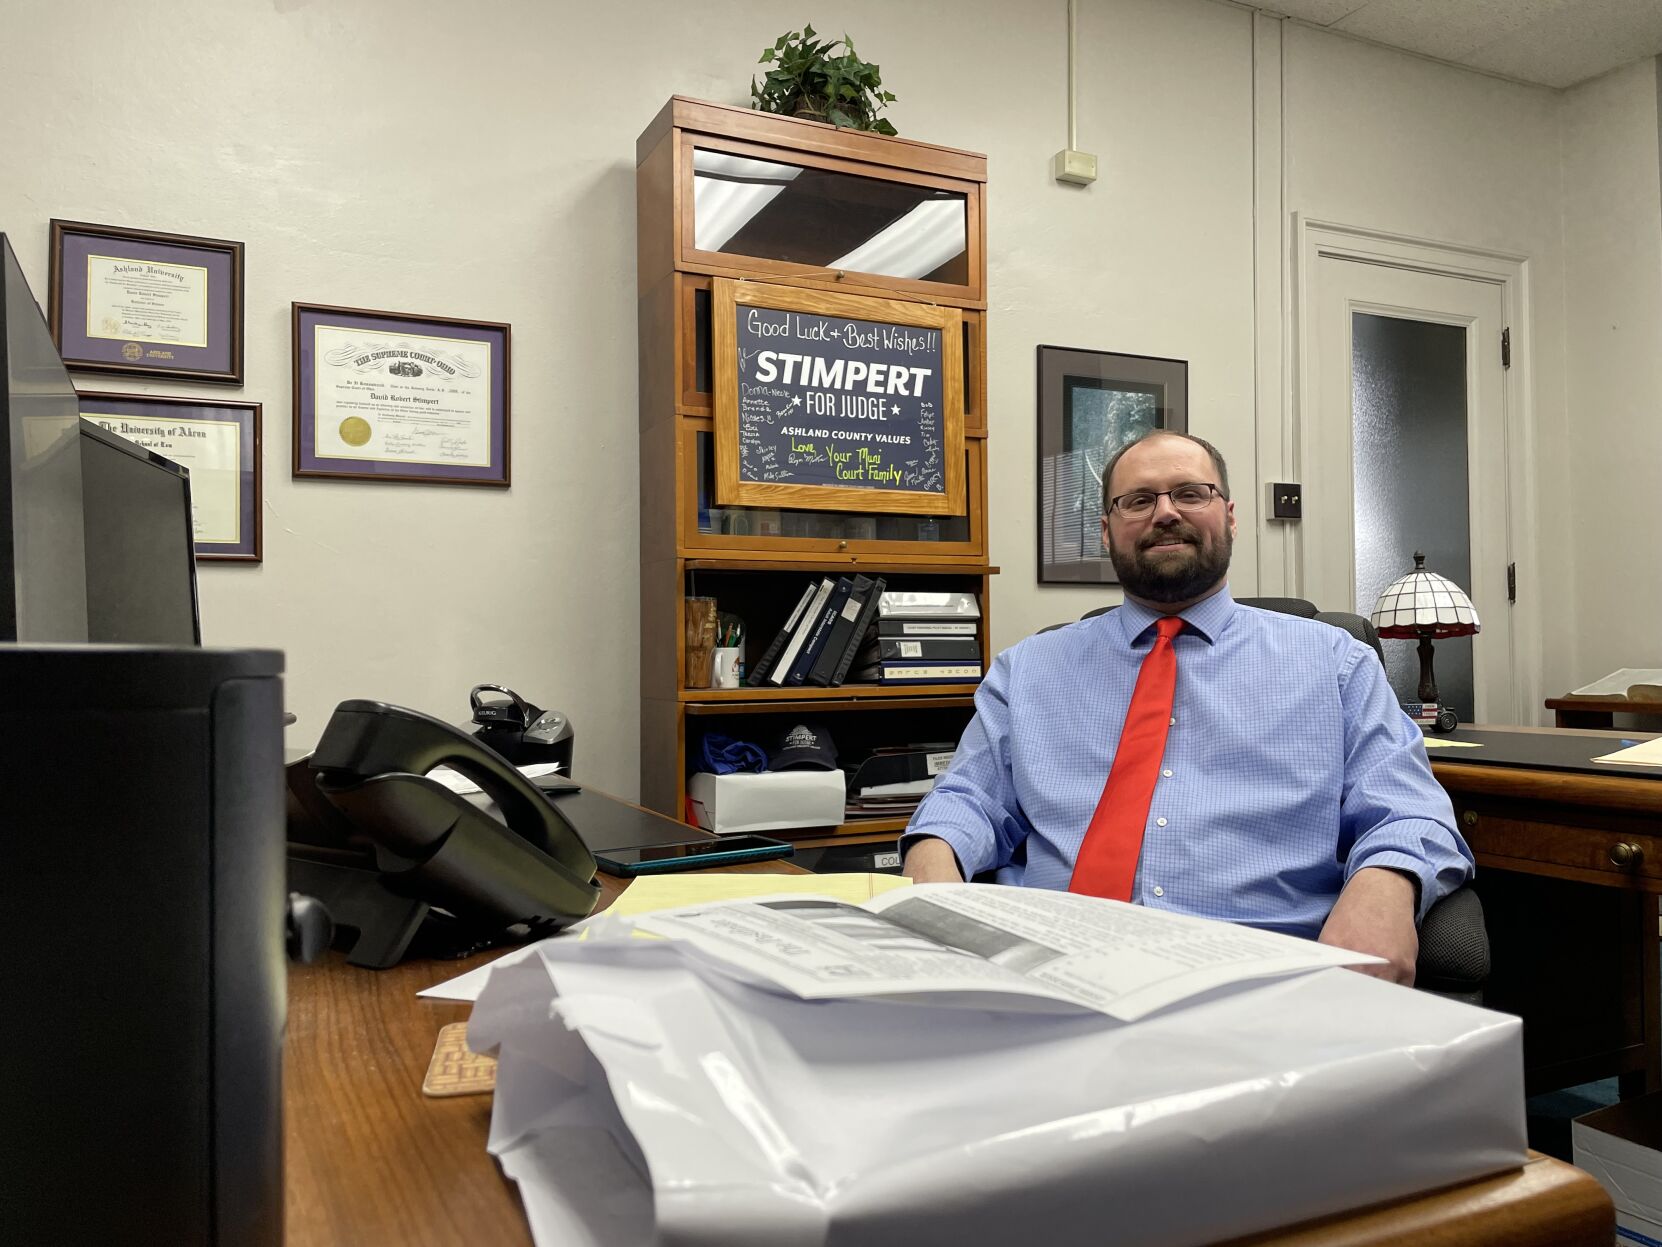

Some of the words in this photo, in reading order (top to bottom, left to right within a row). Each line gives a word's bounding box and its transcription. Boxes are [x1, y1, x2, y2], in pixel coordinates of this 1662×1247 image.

[114, 265, 143, 273] Ashland
[147, 266, 185, 283] University
[748, 309, 789, 338] Good
[796, 315, 830, 341] Luck
[842, 323, 880, 350] Best
[883, 327, 936, 355] Wishes!!
[354, 355, 371, 366] THE
[371, 350, 409, 361] SUPREME
[409, 351, 435, 365] COURT
[436, 360, 456, 375] OHIO
[755, 350, 932, 397] STIMPERT
[370, 392, 389, 401] David
[390, 394, 411, 403] Robert
[412, 396, 440, 405] Stimpert
[806, 391, 836, 417] FOR
[840, 395, 888, 420] JUDGE
[120, 422, 166, 437] University
[167, 428, 177, 437] of
[178, 426, 207, 438] Akron
[781, 426, 829, 438] ASHLAND
[832, 430, 873, 442] COUNTY
[875, 434, 911, 444] VALUES
[825, 443, 852, 466] Your
[856, 447, 882, 470] Muni
[836, 462, 864, 480] Court
[868, 463, 903, 486] Family
